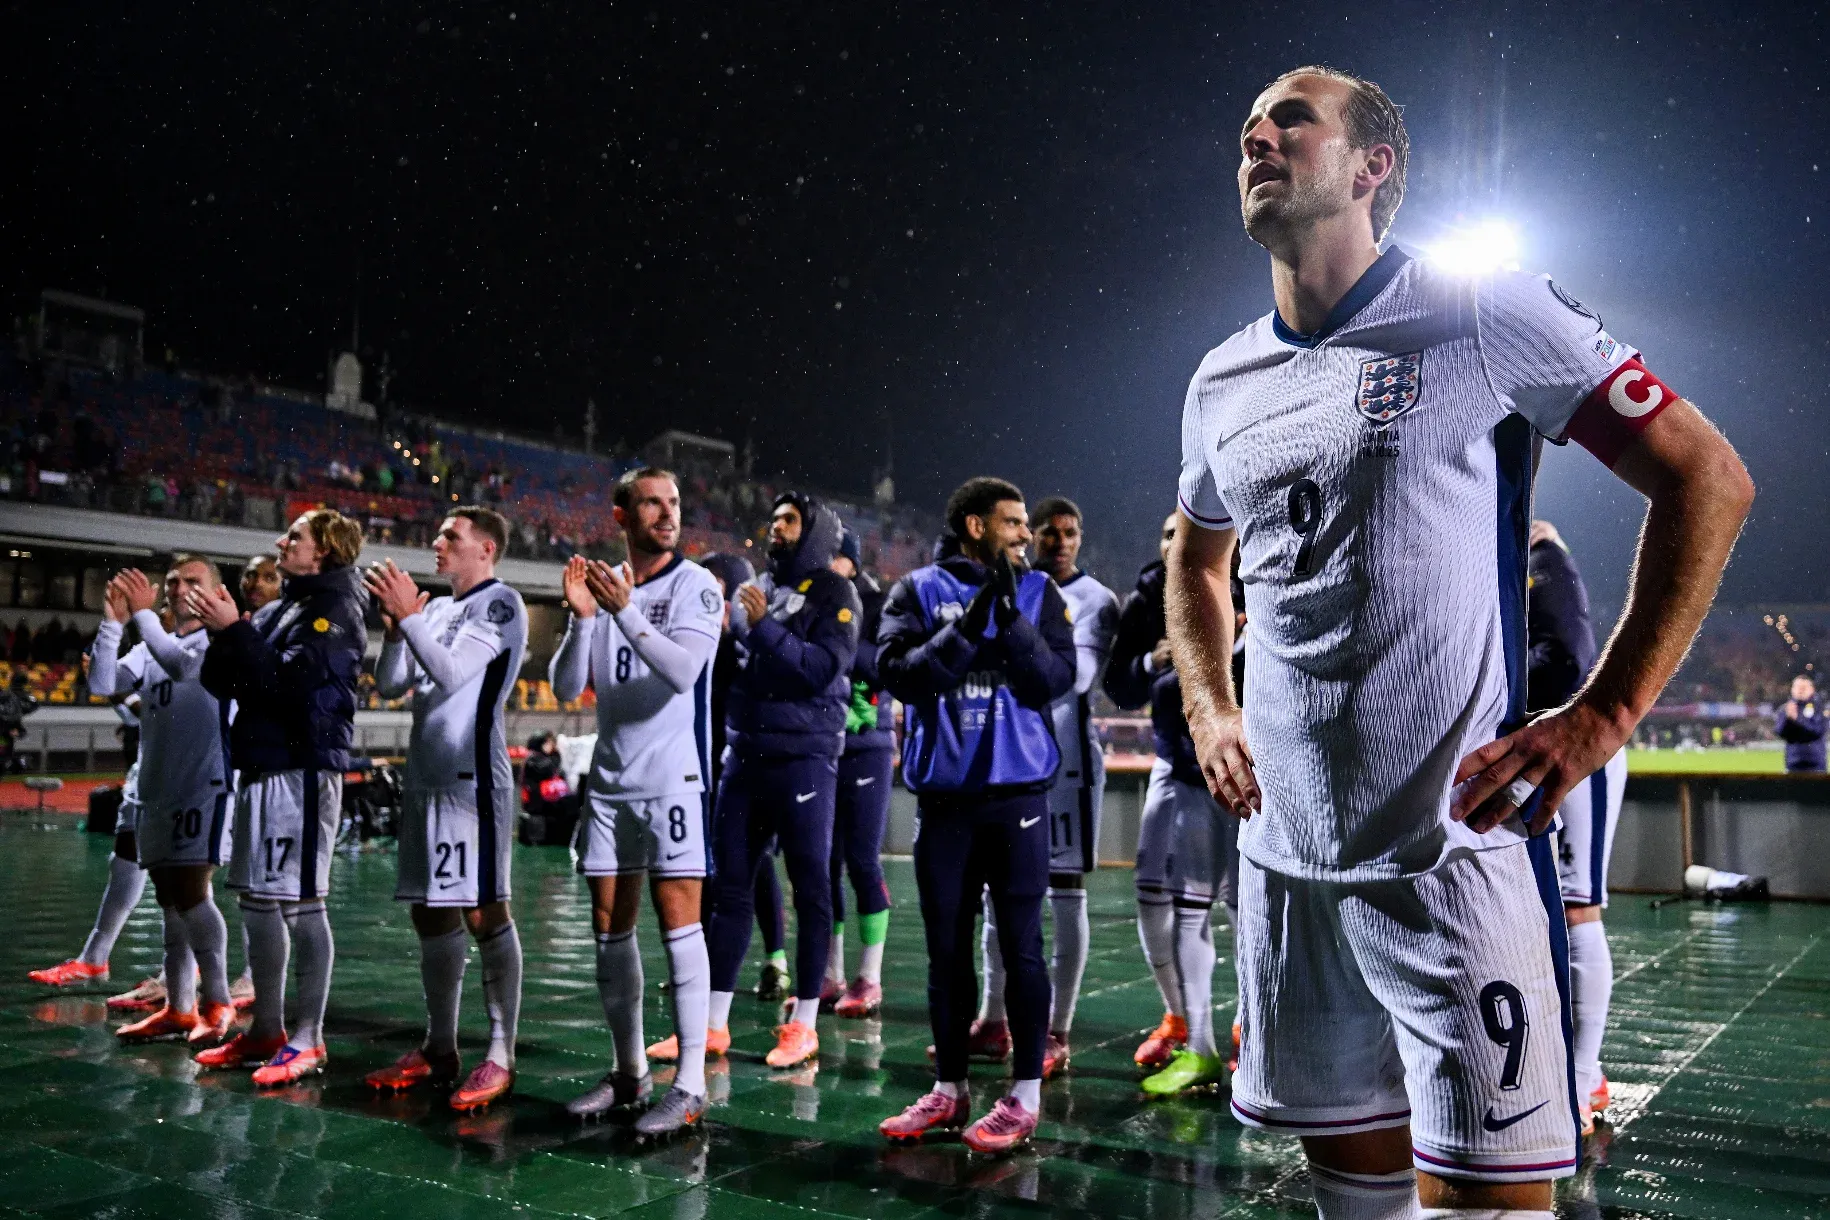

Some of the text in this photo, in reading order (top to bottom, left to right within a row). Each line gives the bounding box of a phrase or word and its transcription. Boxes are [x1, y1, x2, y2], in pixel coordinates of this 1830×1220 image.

[1608, 369, 1663, 418] C
[1361, 445, 1400, 459] 14.10.25
[1363, 429, 1400, 442] LATVIA
[1288, 479, 1324, 575] 9
[616, 646, 632, 684] 8
[172, 808, 202, 841] 20
[669, 804, 687, 843] 8
[1050, 812, 1072, 847] 11
[264, 836, 294, 872] 17
[435, 841, 467, 878] 21
[1480, 980, 1529, 1091] 9
